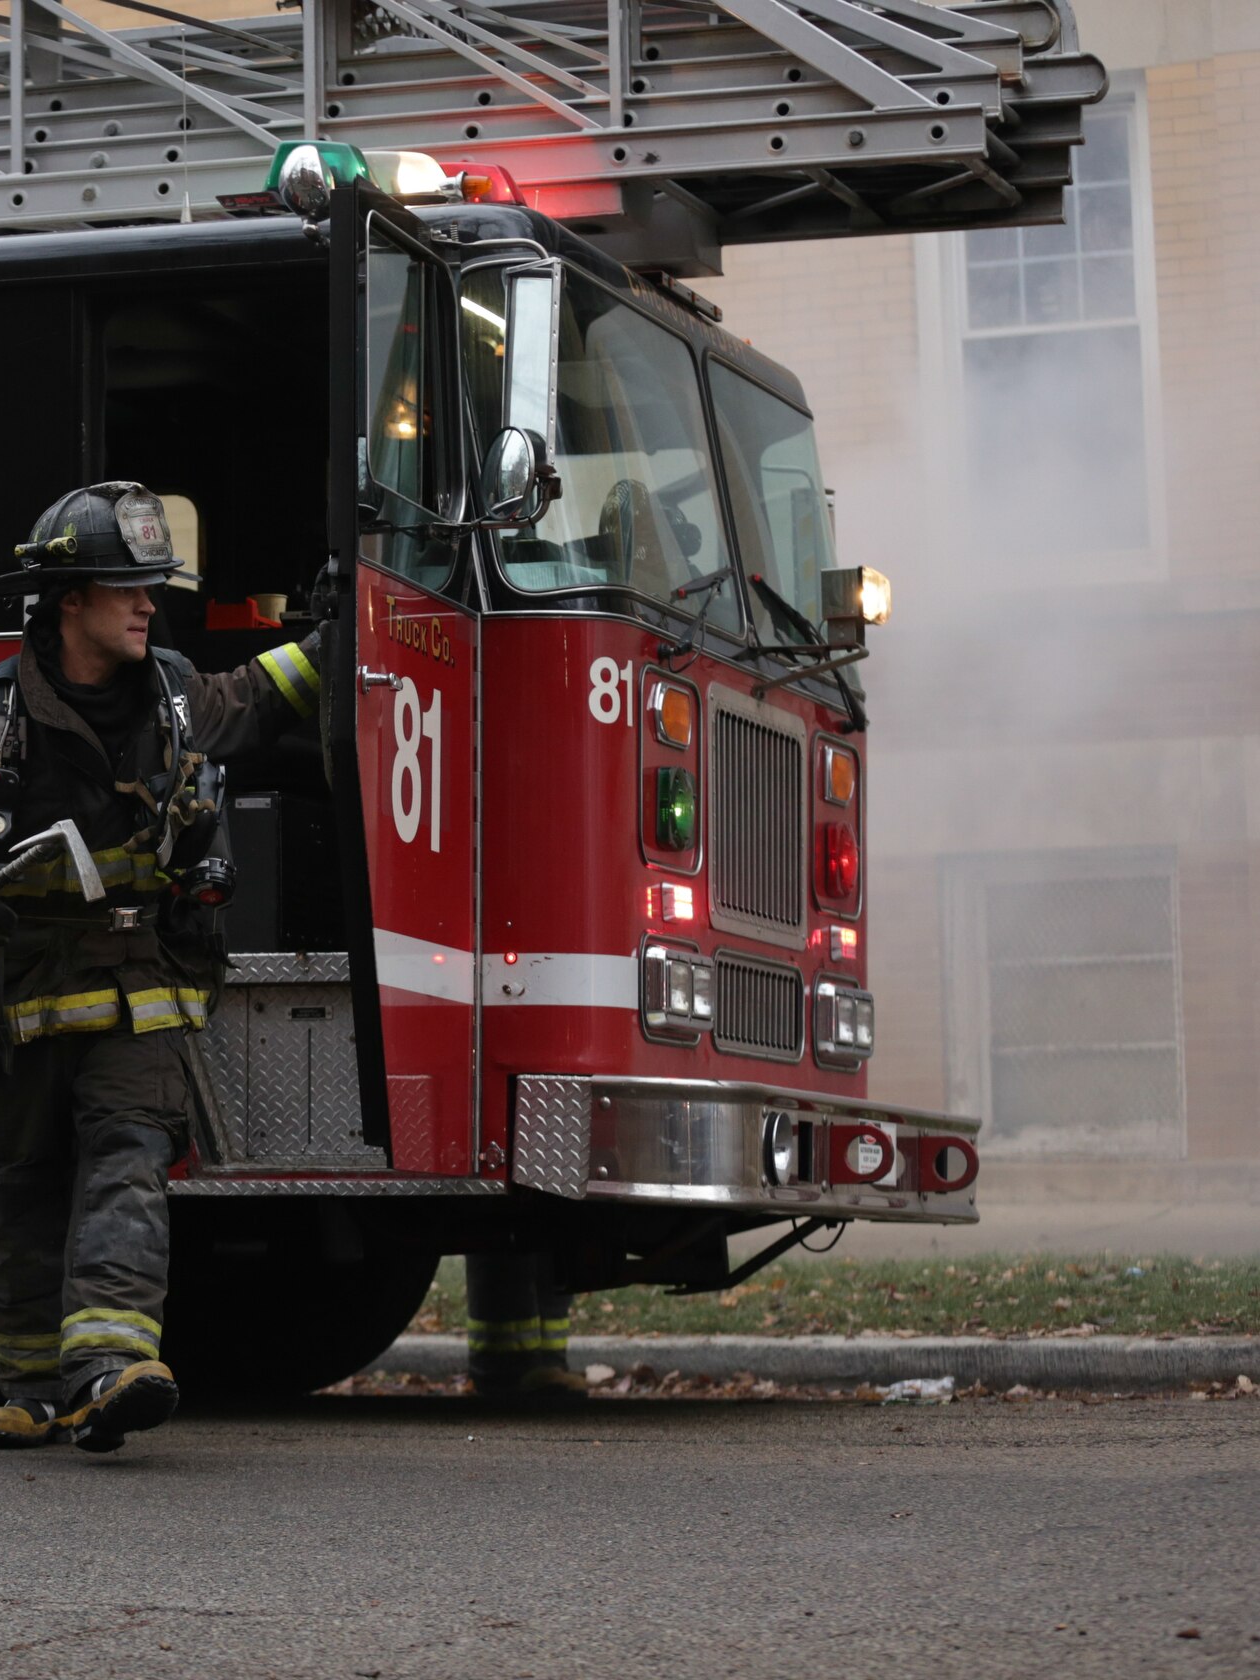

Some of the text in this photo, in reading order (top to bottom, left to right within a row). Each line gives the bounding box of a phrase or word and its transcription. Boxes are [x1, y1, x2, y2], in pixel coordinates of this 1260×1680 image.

[141, 549, 167, 558] CHICAGO
[142, 525, 157, 540] 81
[386, 595, 428, 656] TRUCK
[589, 656, 633, 727] 81
[392, 676, 441, 853] 81
